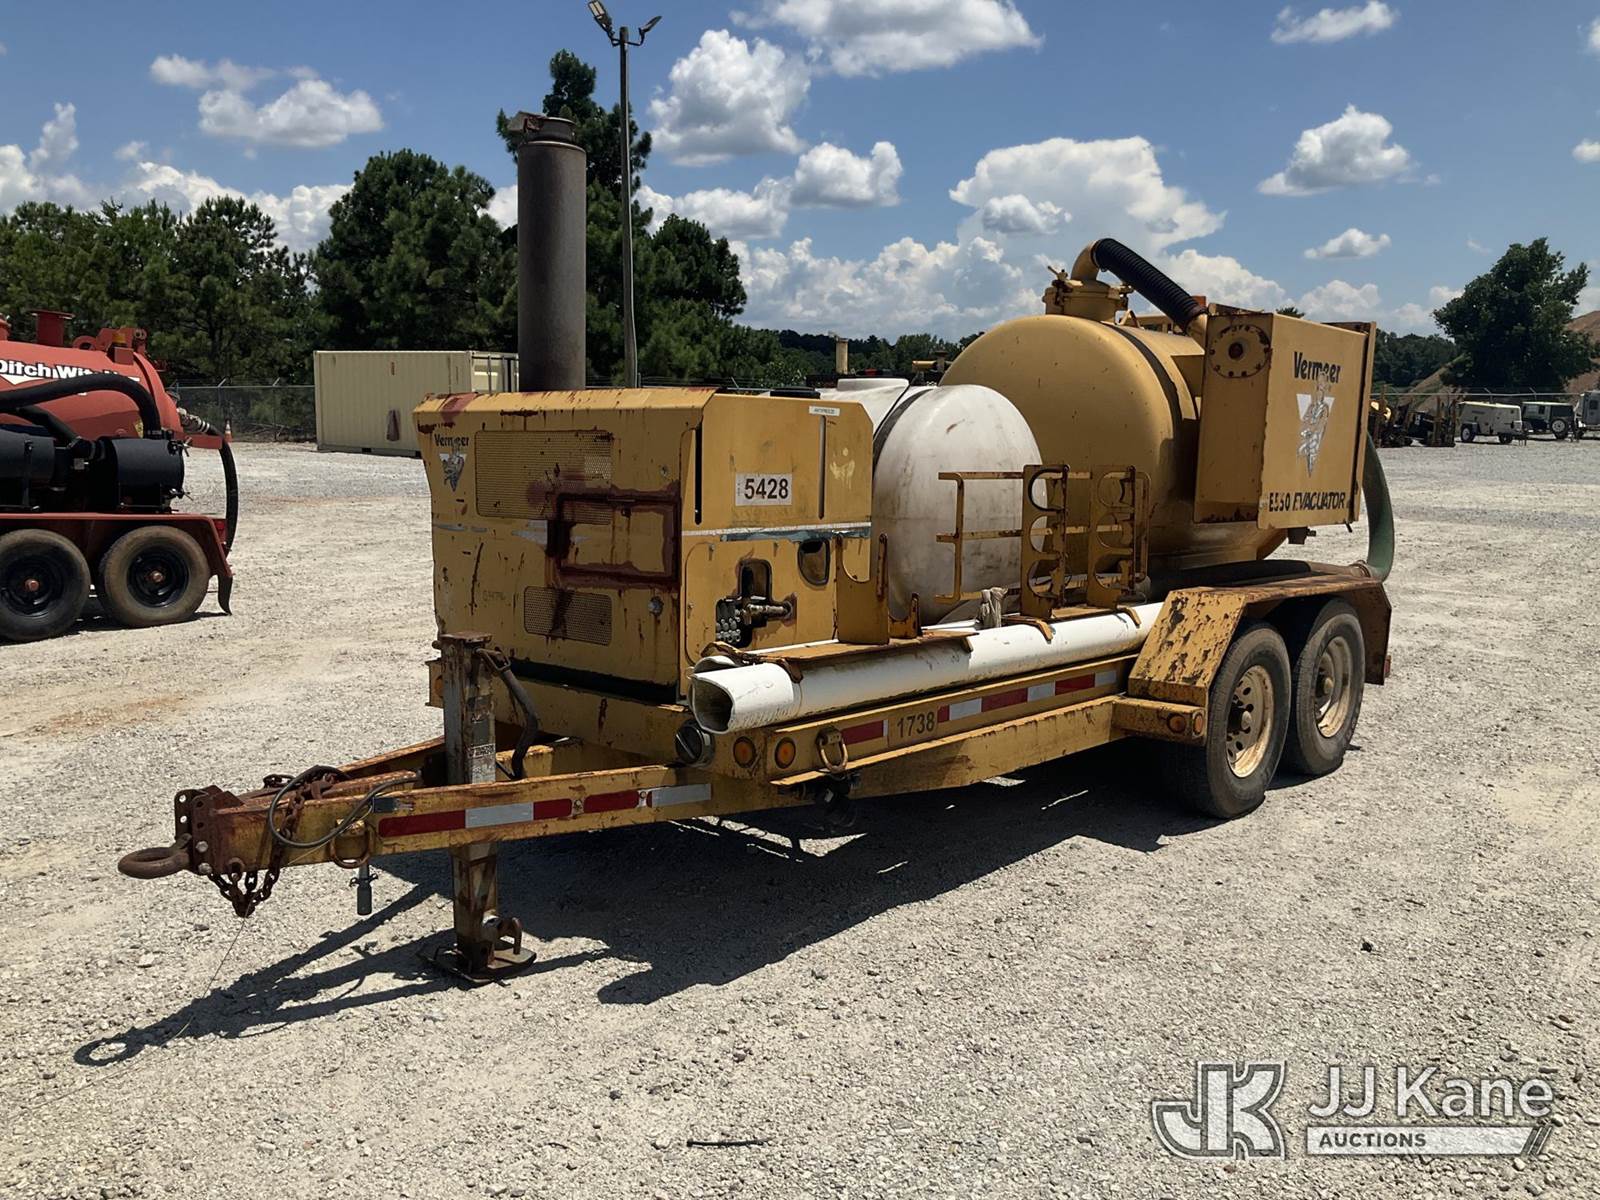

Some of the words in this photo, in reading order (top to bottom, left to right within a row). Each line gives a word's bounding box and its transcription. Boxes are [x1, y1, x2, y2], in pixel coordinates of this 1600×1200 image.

[1294, 351, 1341, 384] Vermeer
[744, 478, 789, 500] 5428
[1292, 491, 1346, 511] EVACUATOR
[897, 711, 935, 738] 1738
